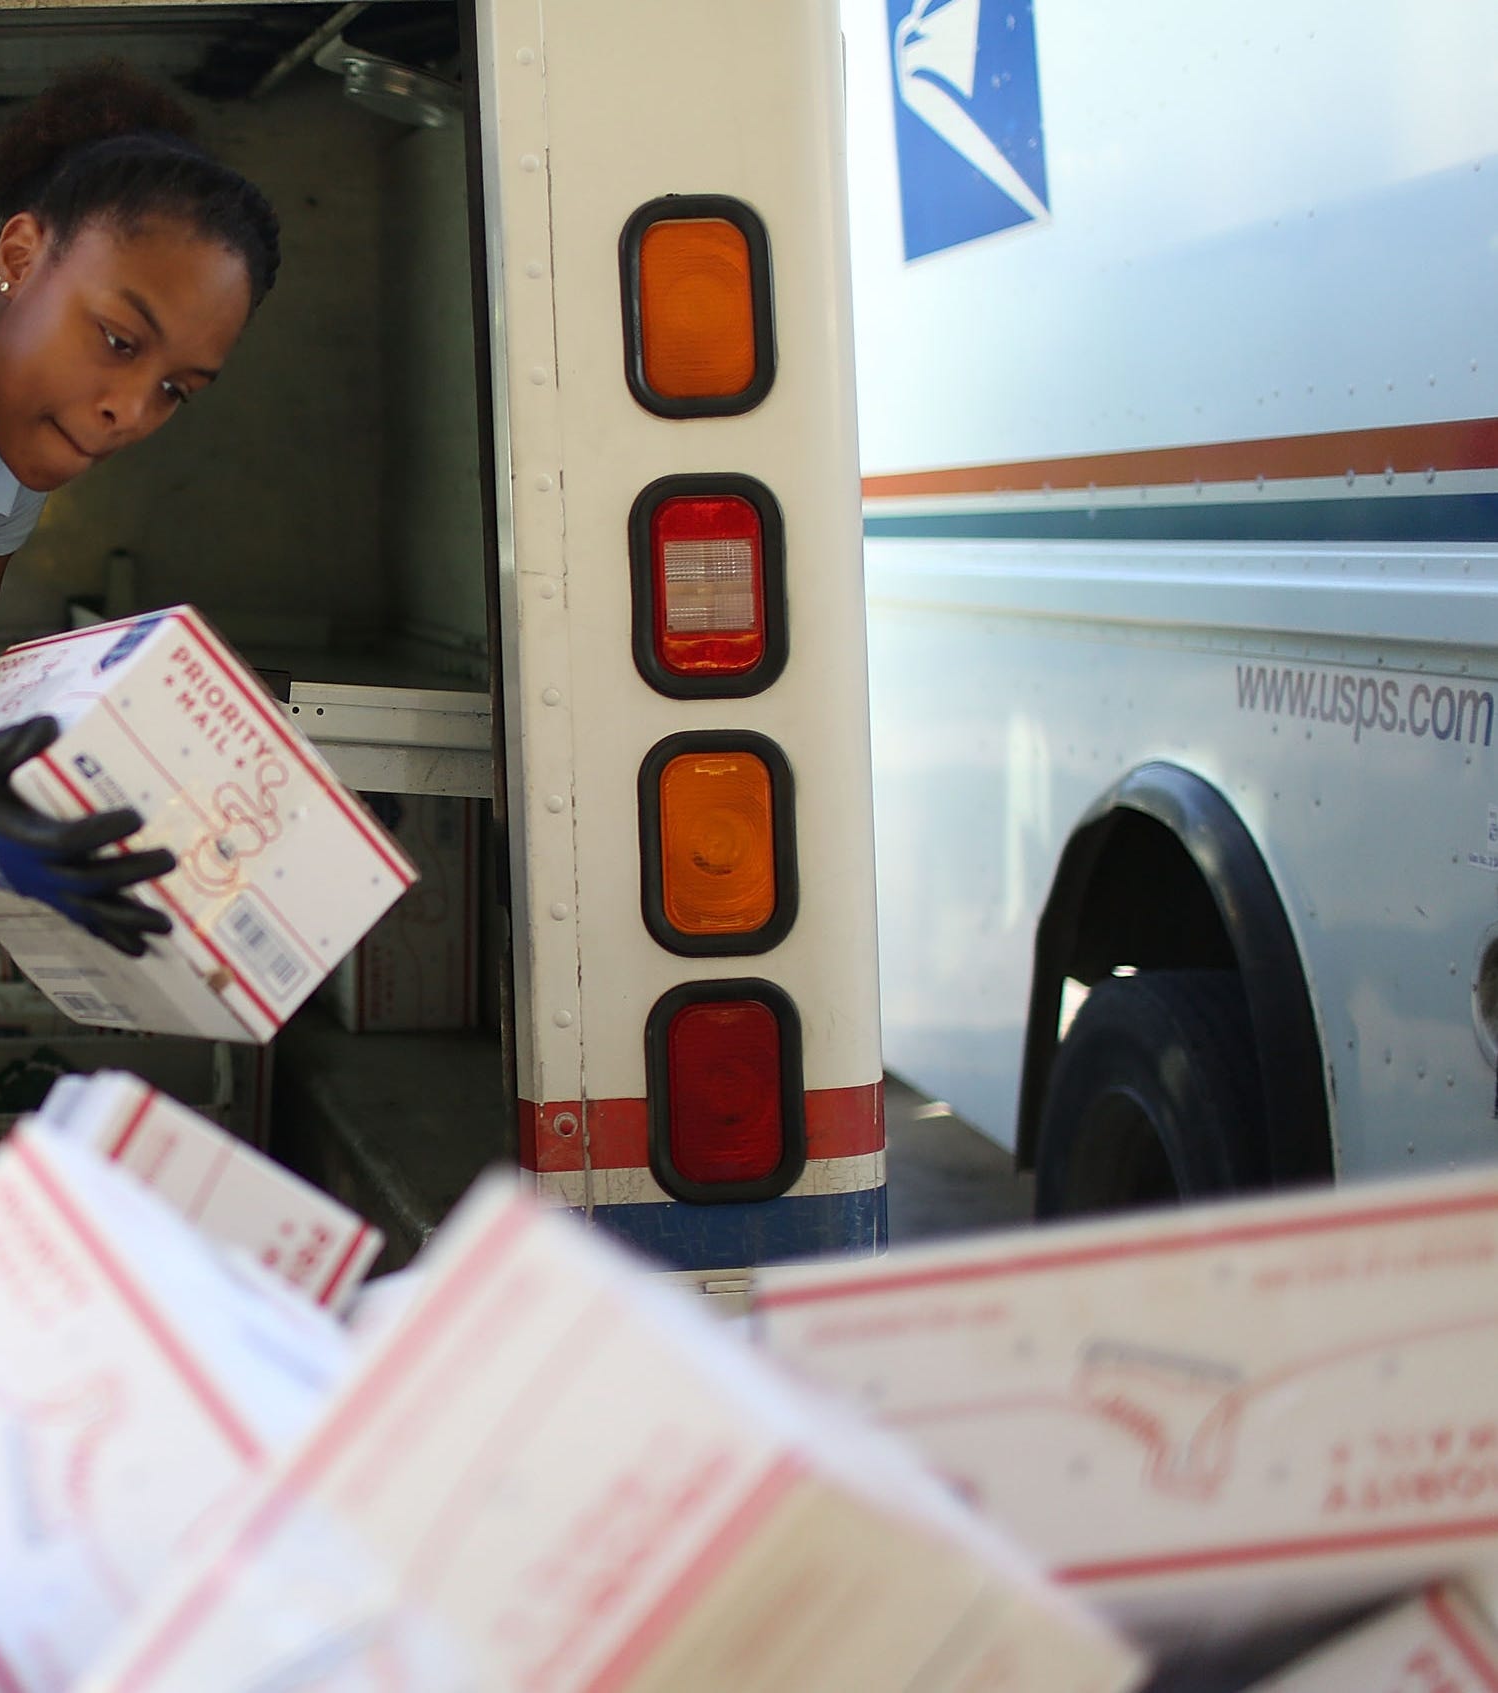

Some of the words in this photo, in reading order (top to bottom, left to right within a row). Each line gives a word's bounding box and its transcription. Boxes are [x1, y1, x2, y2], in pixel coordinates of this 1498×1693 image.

[170, 645, 274, 759] PRIORITY
[175, 689, 230, 757] MAIL
[1237, 665, 1494, 746] www.usps.com
